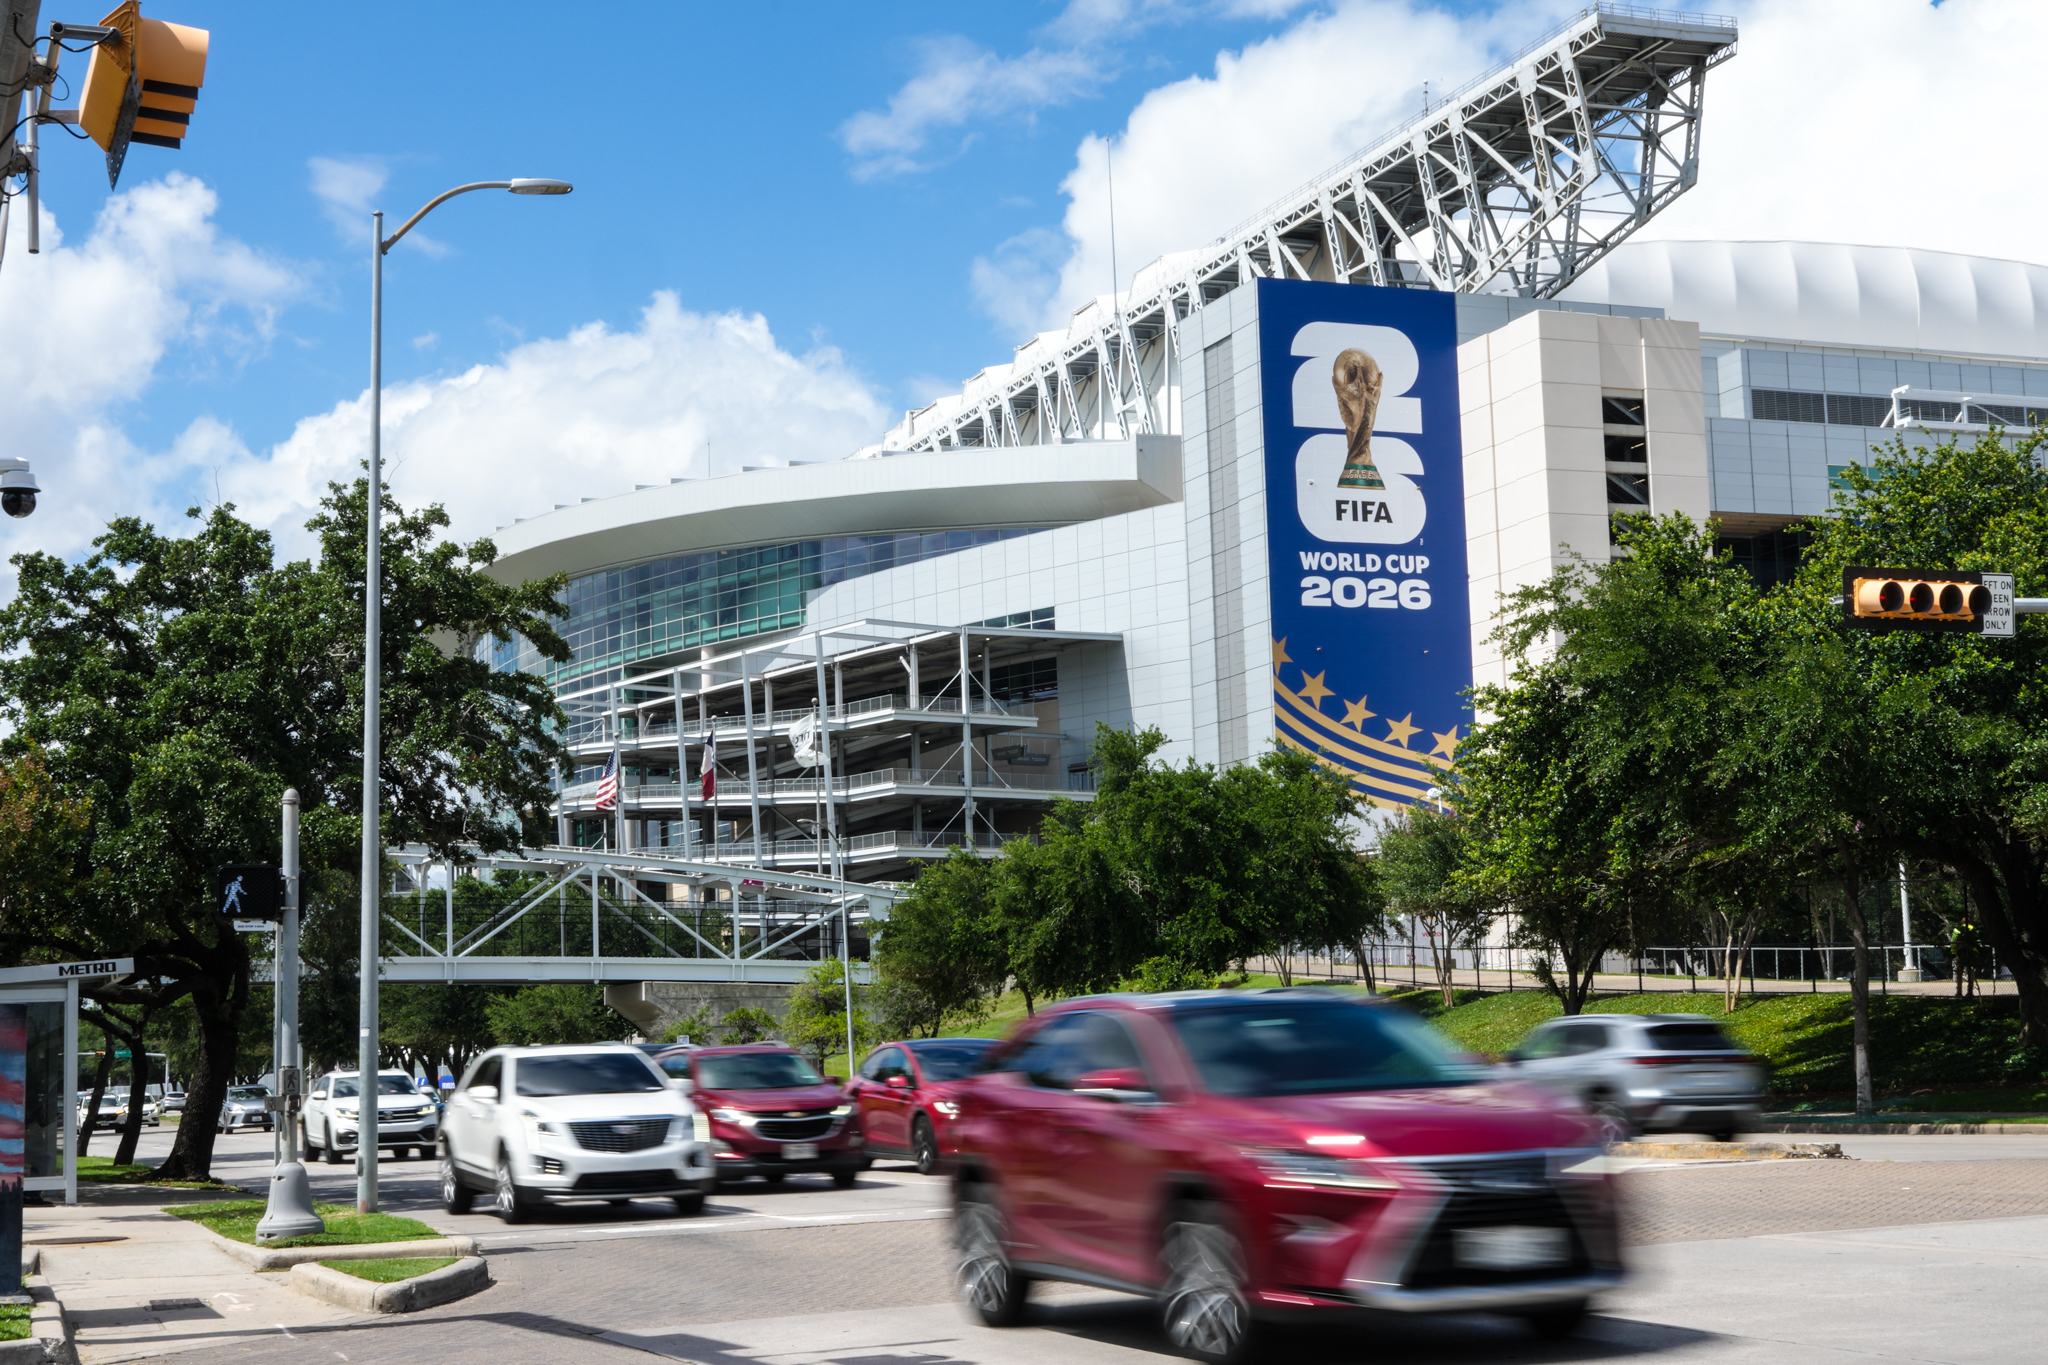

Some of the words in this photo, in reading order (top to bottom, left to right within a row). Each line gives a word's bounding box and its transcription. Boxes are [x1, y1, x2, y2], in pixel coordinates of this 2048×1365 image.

[1335, 499, 1394, 524] FIFA
[1299, 551, 1381, 573] WORLD
[1385, 554, 1430, 574] CUP
[1984, 581, 1997, 589] EFT
[2001, 581, 2011, 590] ON
[1300, 576, 1432, 611] 2026
[1994, 594, 2008, 603] EEN
[1986, 607, 2010, 616] RROW
[1985, 620, 2006, 629] ONLY
[58, 961, 117, 977] METRO
